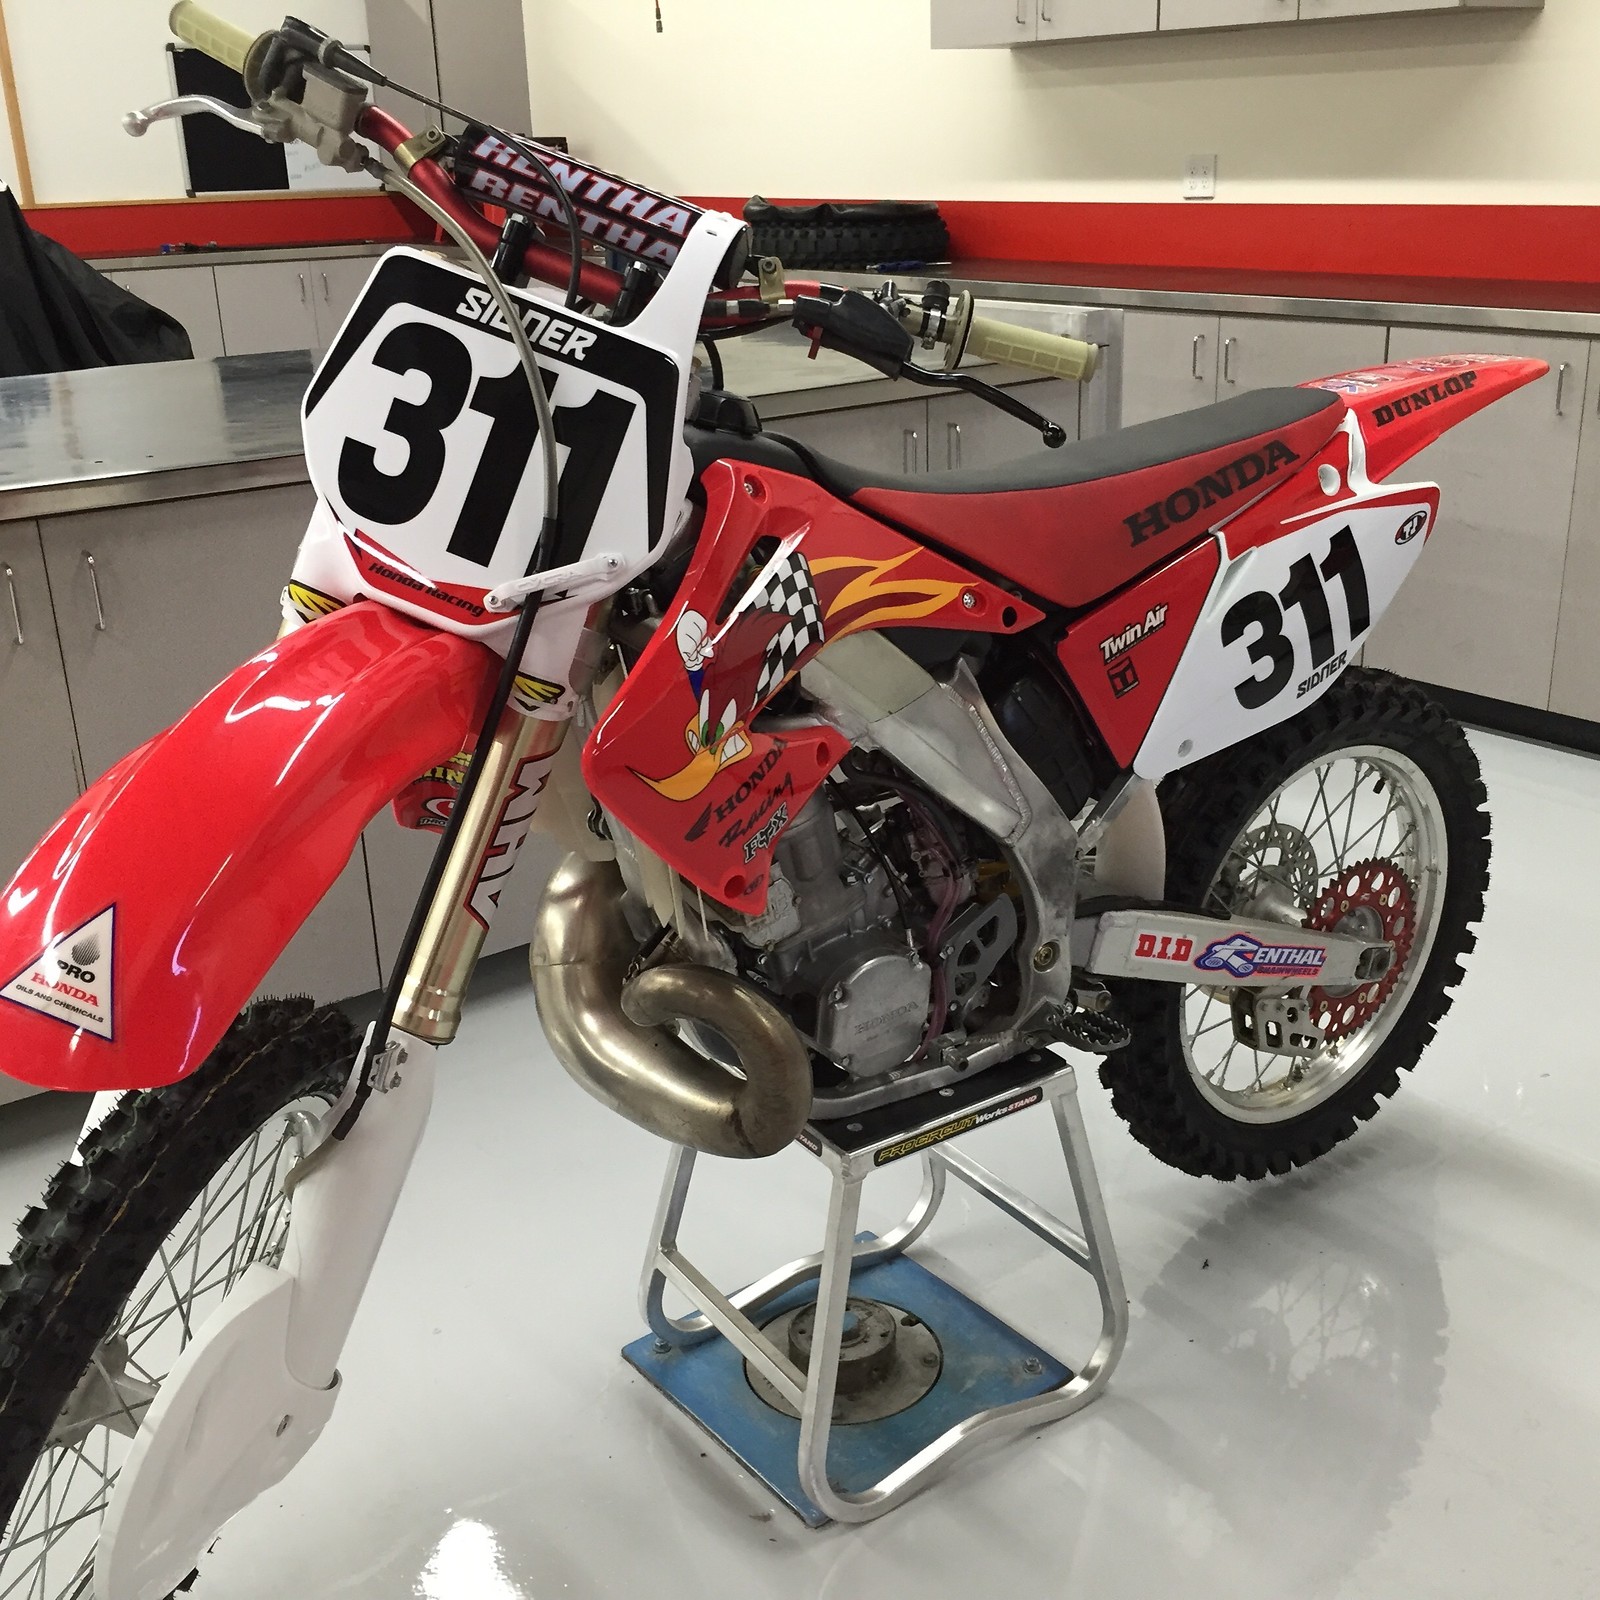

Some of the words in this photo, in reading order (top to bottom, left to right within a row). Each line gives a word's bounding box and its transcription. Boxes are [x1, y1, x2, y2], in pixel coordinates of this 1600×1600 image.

[473, 133, 691, 237] RENTHA
[470, 168, 680, 267] RENTHA
[1372, 370, 1478, 428] DUNLOP
[338, 322, 638, 598] 311
[1122, 439, 1300, 548] HONDA
[368, 562, 425, 591] Honda
[425, 586, 486, 618] Racing
[1220, 525, 1371, 711] 311
[1099, 622, 1143, 662] Twin
[1143, 603, 1169, 635] Air
[1296, 650, 1348, 700] SIDNER
[712, 738, 788, 825] HONDA
[718, 772, 794, 848] Racing
[743, 802, 789, 864] FOX
[57, 959, 96, 984] PRO
[1134, 933, 1194, 963] D.I.D
[15, 984, 34, 996] OILS
[34, 990, 53, 1003] AND
[53, 998, 105, 1024] CHEMICALS
[974, 1106, 1009, 1125] Works
[1007, 1094, 1038, 1112] STAND
[797, 1133, 819, 1151] TAND
